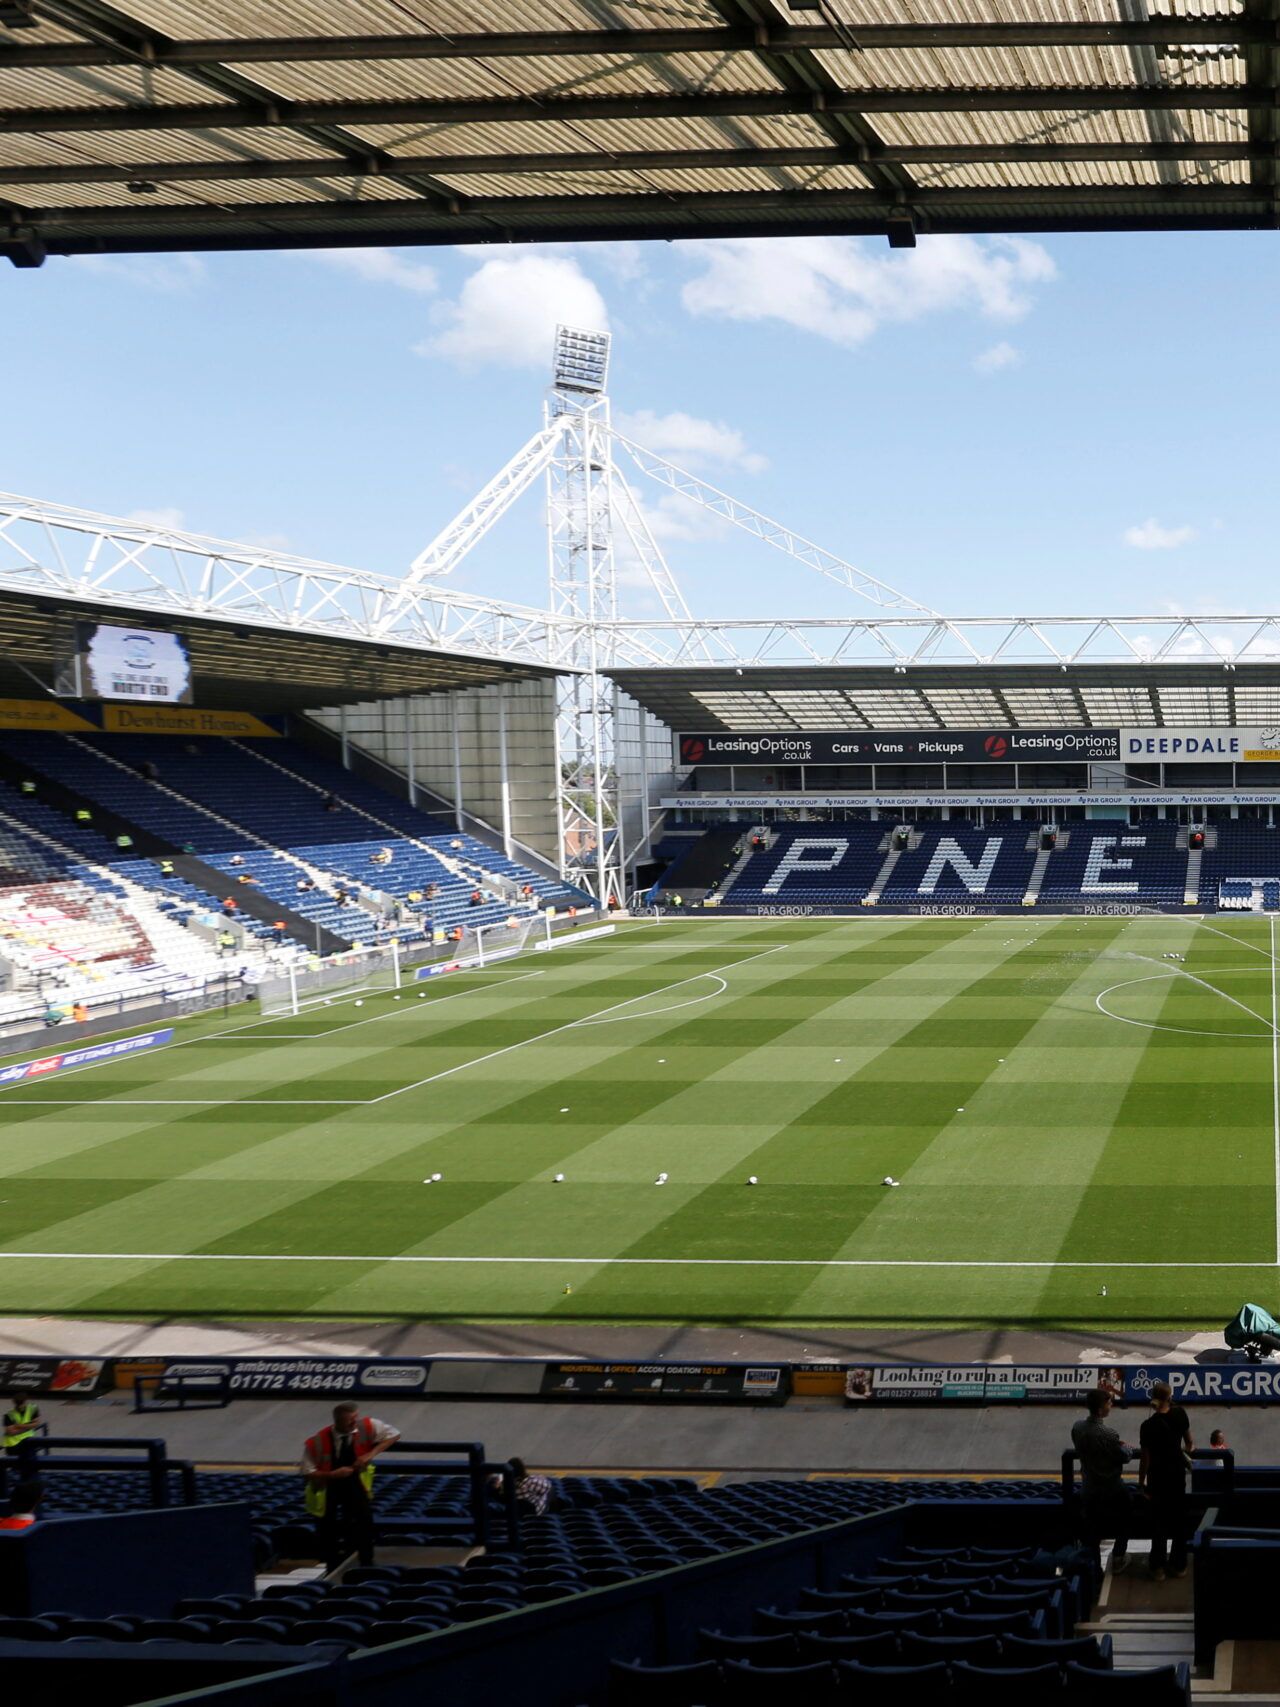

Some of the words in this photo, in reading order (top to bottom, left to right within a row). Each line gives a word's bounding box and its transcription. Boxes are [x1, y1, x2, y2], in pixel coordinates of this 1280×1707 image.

[118, 709, 196, 729] Dewhurst
[202, 715, 250, 731] Homes
[708, 738, 812, 754] LeasingOptions
[832, 743, 859, 753] Cars
[874, 743, 904, 753] Vans
[918, 742, 964, 755] Pickups
[1012, 734, 1117, 750] LeasingOptions
[1129, 737, 1239, 754] DEEPDALE
[782, 751, 811, 760] .co.uk
[1087, 748, 1117, 757] .co.uk
[762, 838, 849, 894] P
[917, 837, 1003, 894] N
[1081, 836, 1147, 893] E
[757, 906, 834, 917] PAR-GROUP.co.uk
[919, 906, 997, 916] PAR-GROUP.co.uk
[1084, 904, 1163, 915] PAR-GROUP.co.uk
[0, 1069, 29, 1083] sky
[31, 1057, 61, 1073] bet
[63, 1045, 114, 1065] BETTING
[114, 1036, 155, 1053] BETTER
[234, 1360, 358, 1373] ambrosehire.com
[560, 1365, 603, 1373] INDUSTRIAL
[611, 1366, 636, 1374] OFFICE
[702, 1366, 712, 1374] TO
[712, 1366, 727, 1374] LET
[367, 1369, 421, 1379] AMBROSE
[878, 1368, 944, 1386] Looking
[946, 1369, 964, 1383] to
[968, 1372, 998, 1383] run
[1000, 1373, 1010, 1383] a
[1012, 1368, 1050, 1383] local
[1053, 1369, 1092, 1386] pub?
[230, 1375, 284, 1390] 01772
[288, 1375, 356, 1389] 436449
[877, 1390, 890, 1398] Call
